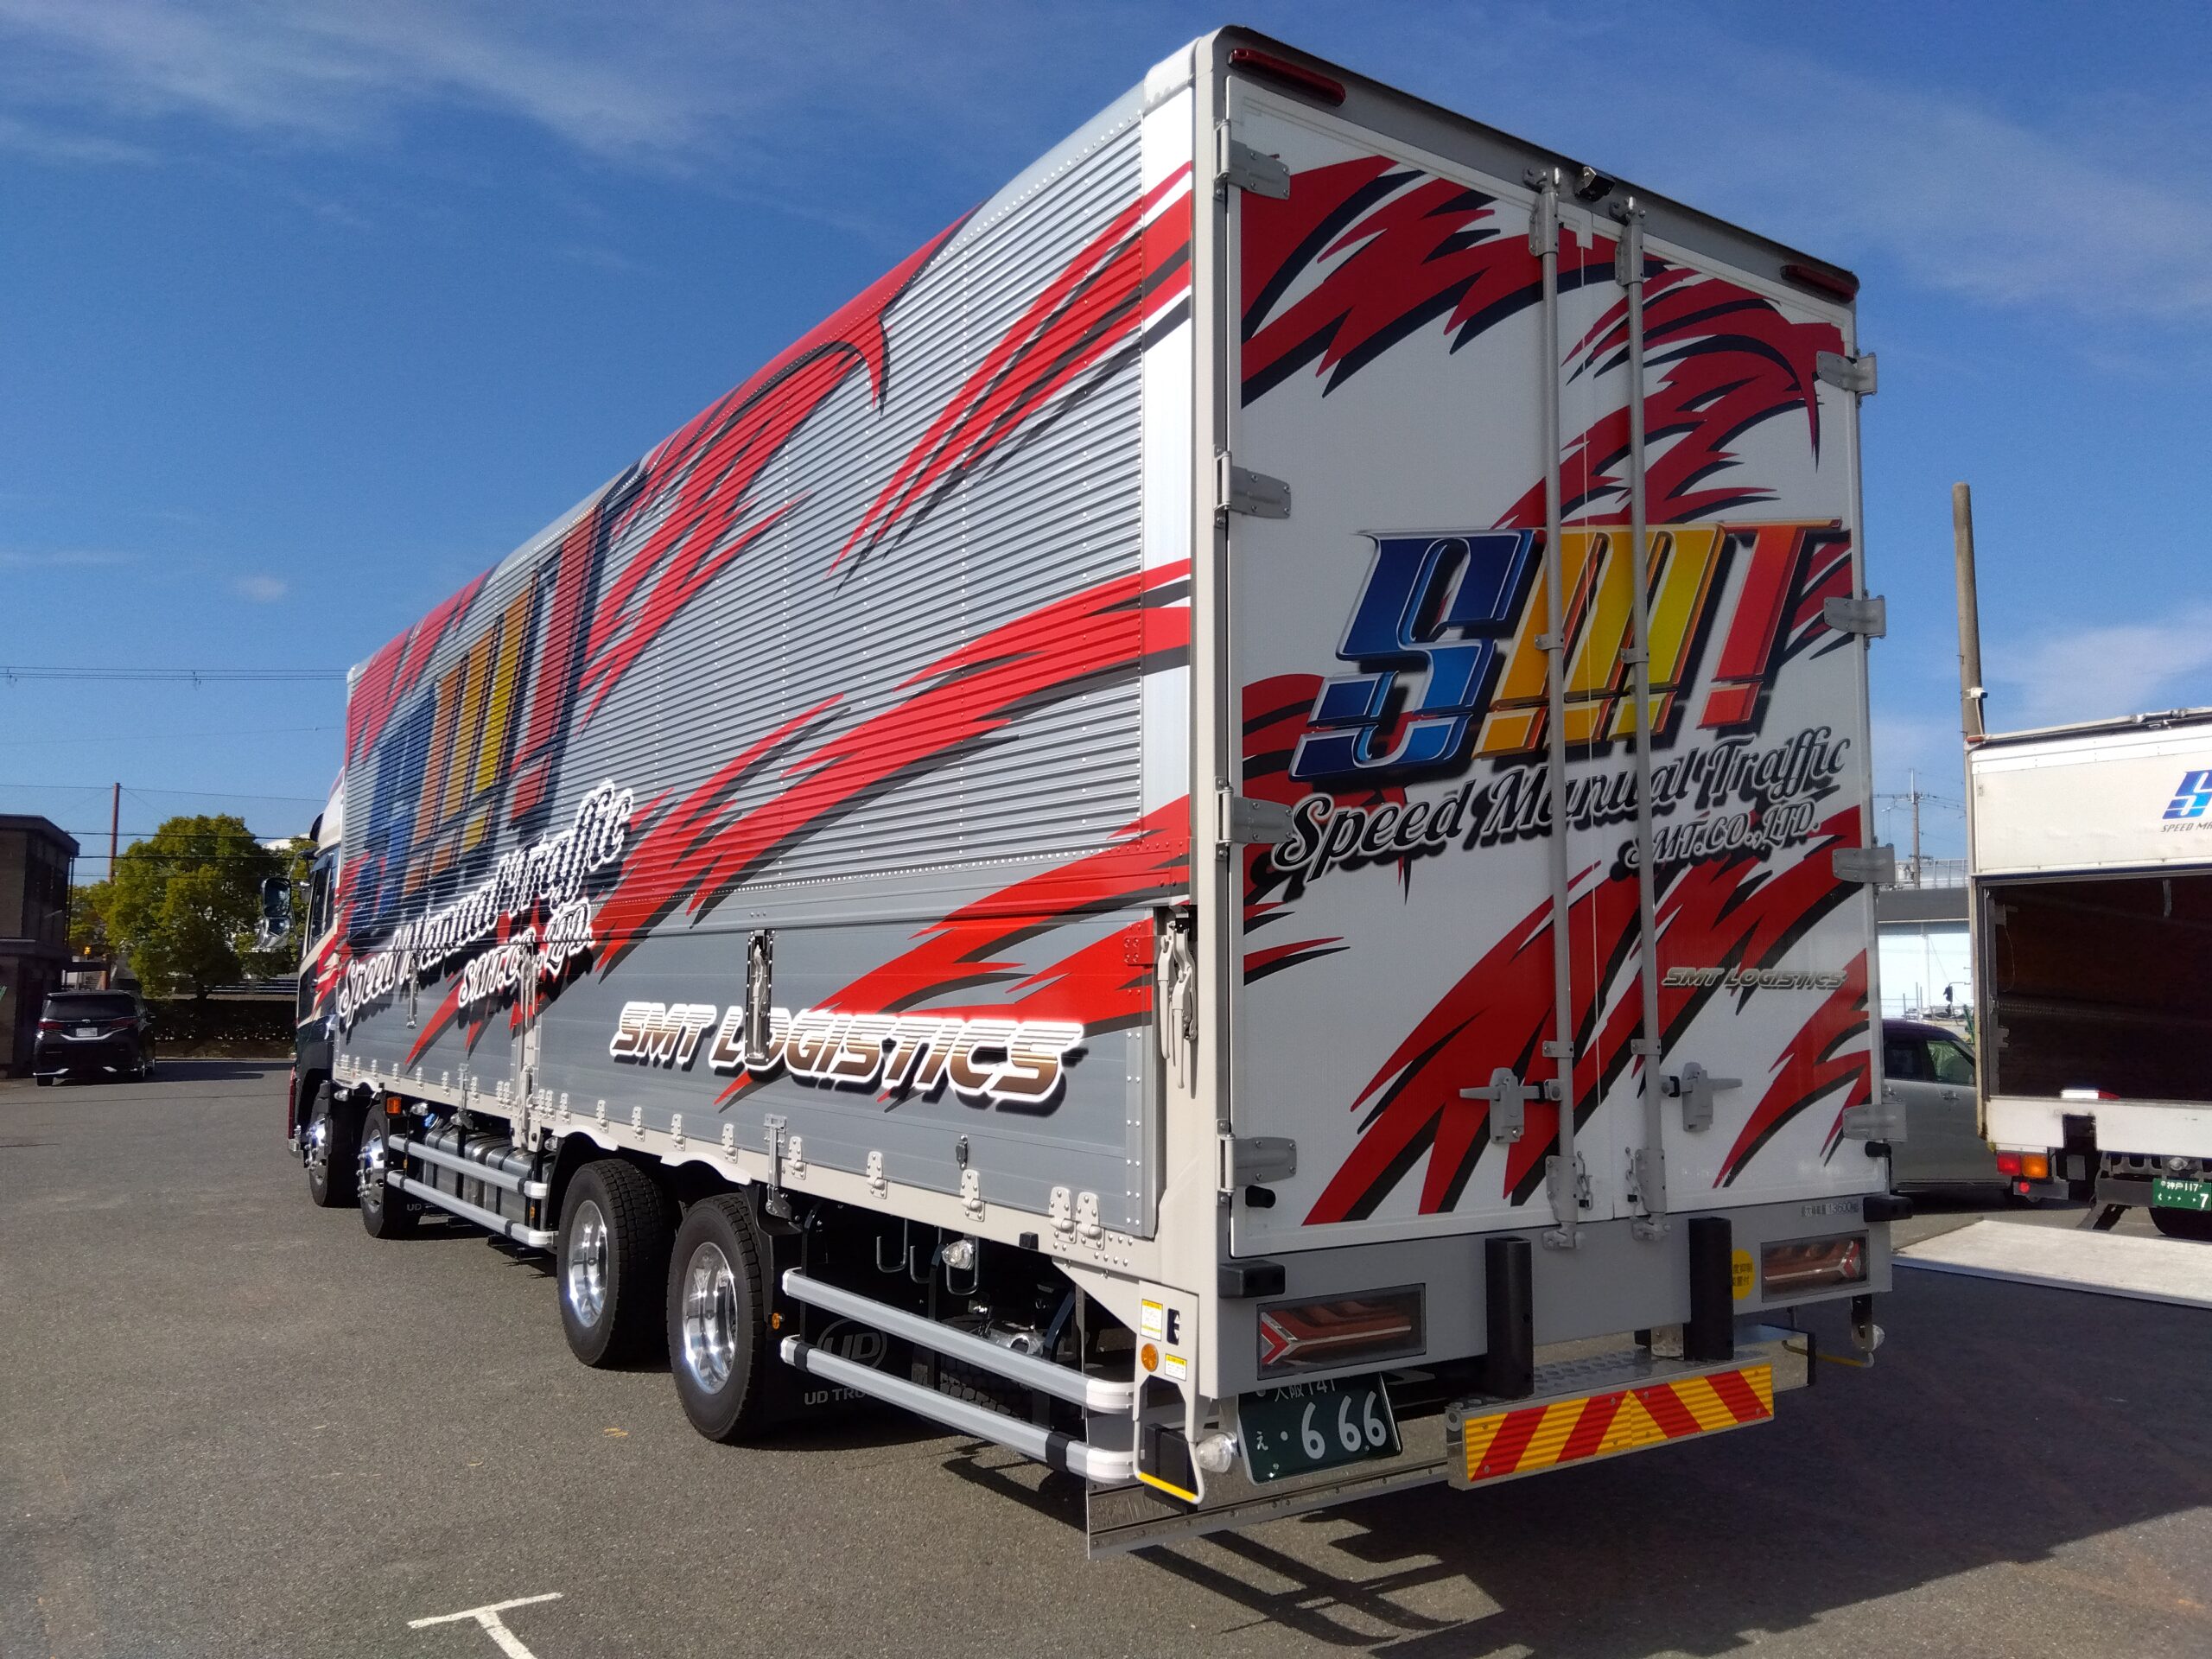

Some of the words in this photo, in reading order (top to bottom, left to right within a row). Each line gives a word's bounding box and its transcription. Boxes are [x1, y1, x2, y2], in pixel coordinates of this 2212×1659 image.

[1289, 518, 1841, 778] SMT
[1274, 781, 1472, 882] Speed
[1484, 746, 1700, 836] Manual
[1700, 726, 1851, 798] Traffic
[2160, 823, 2195, 833] SPEED
[339, 929, 401, 1028] Speed
[1662, 967, 1725, 987] SMT
[1724, 968, 1847, 989] LOGISTICS
[611, 1001, 716, 1058] SMT
[804, 1390, 830, 1405] UD
